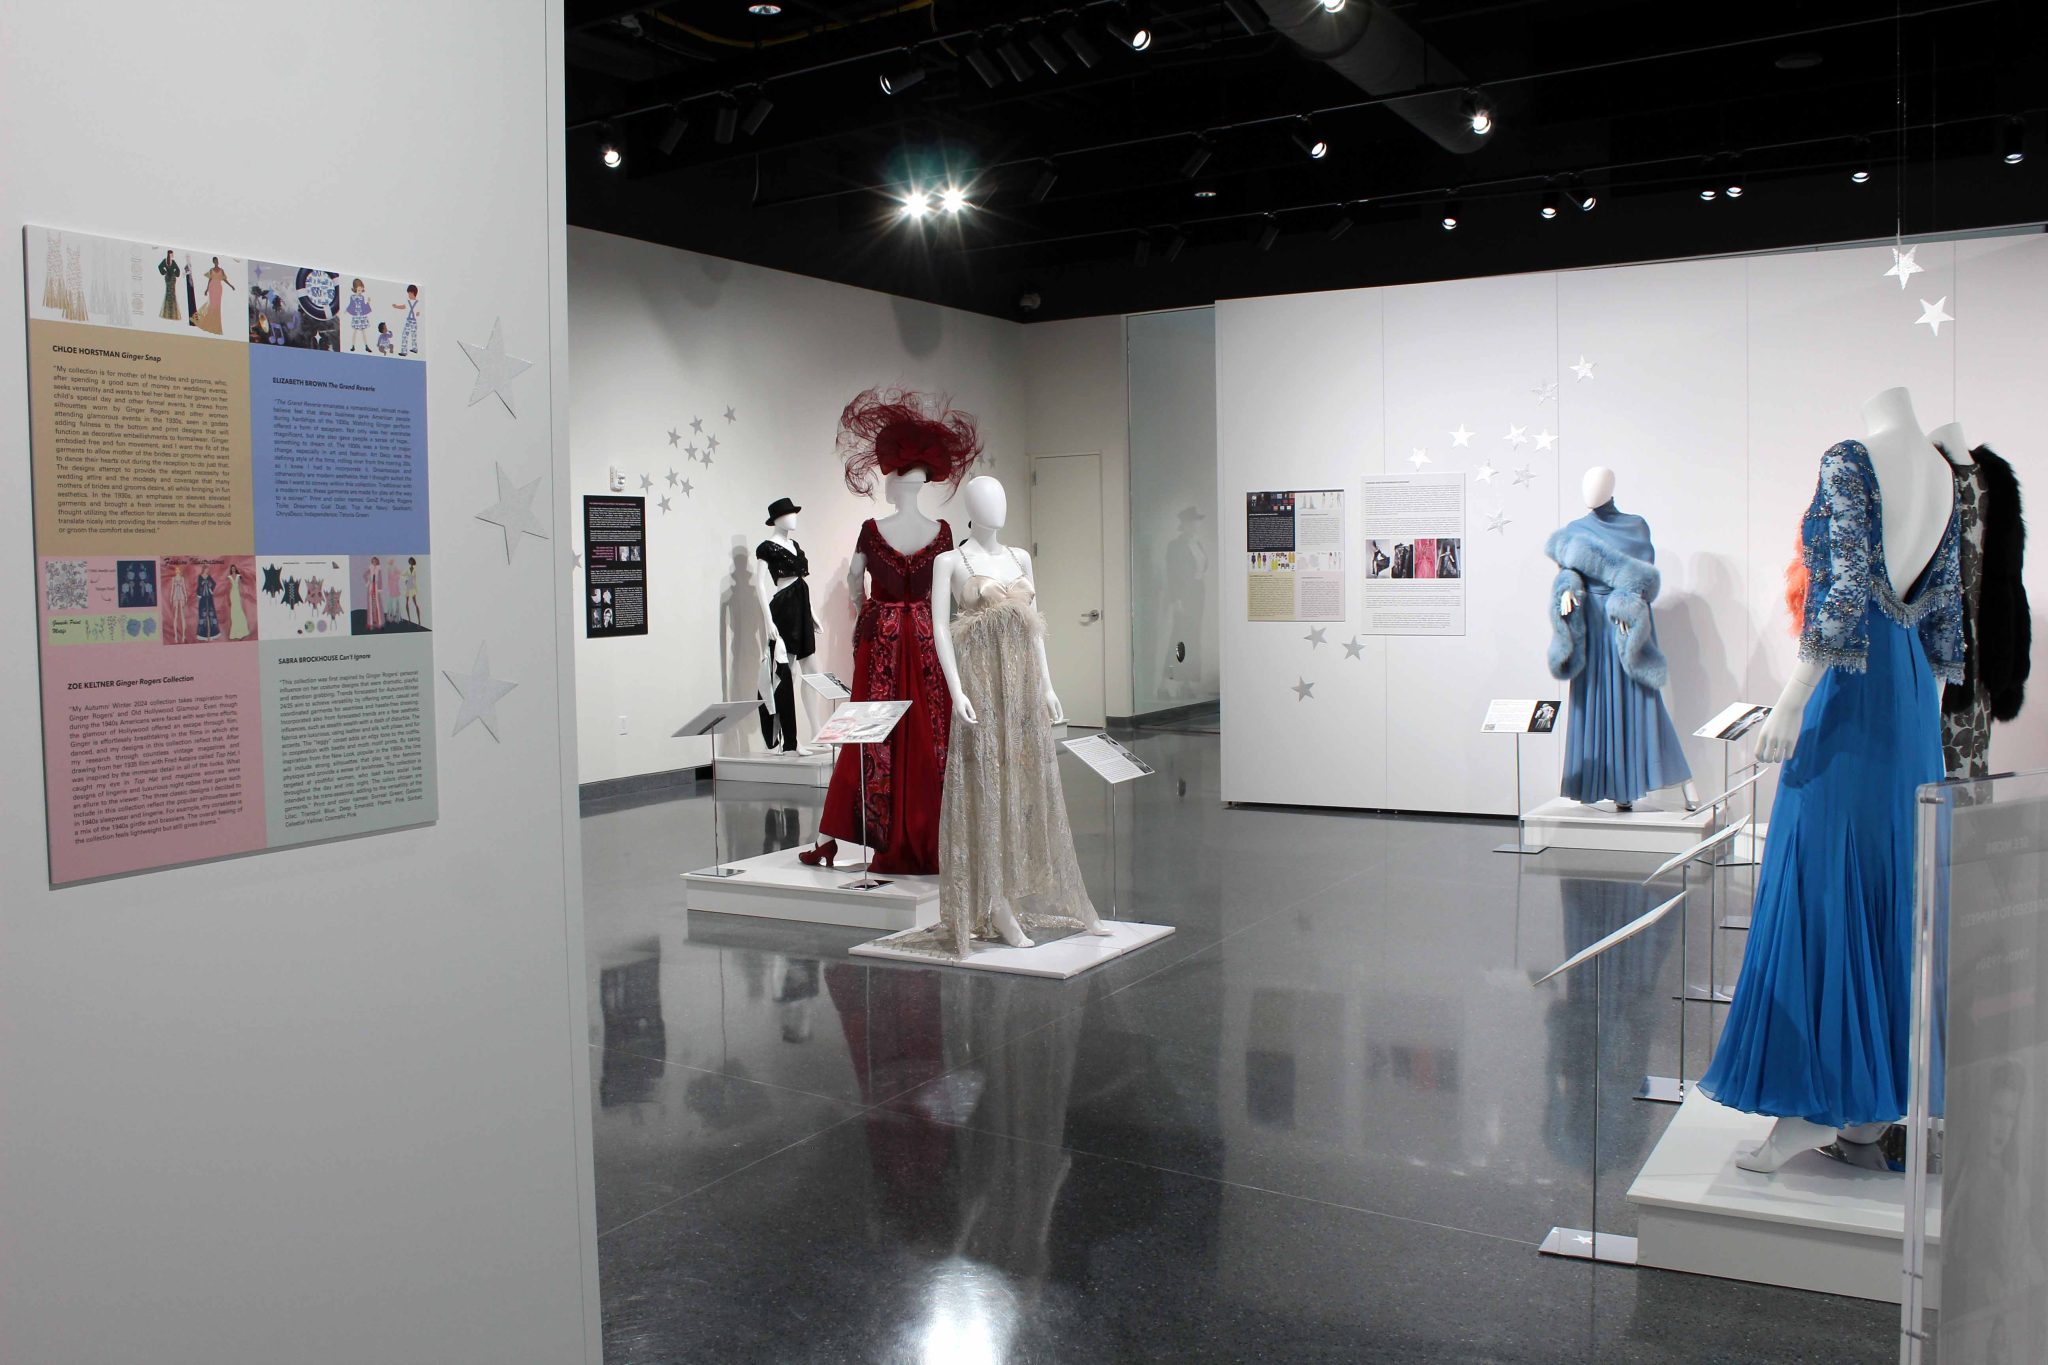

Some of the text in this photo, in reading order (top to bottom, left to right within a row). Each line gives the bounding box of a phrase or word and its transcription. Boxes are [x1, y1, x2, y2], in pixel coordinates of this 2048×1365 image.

[53, 345, 161, 362] CHLOE HORSTMAN Ginger Snap
[273, 377, 304, 386] ELIZABETH
[305, 380, 327, 388] BROWN
[299, 655, 338, 663] BROCKHOUSE
[354, 653, 371, 661] Ignore
[84, 680, 115, 689] KELTNER
[116, 679, 138, 688] Ginger
[139, 677, 162, 686] Rogers
[163, 675, 194, 683] Collection
